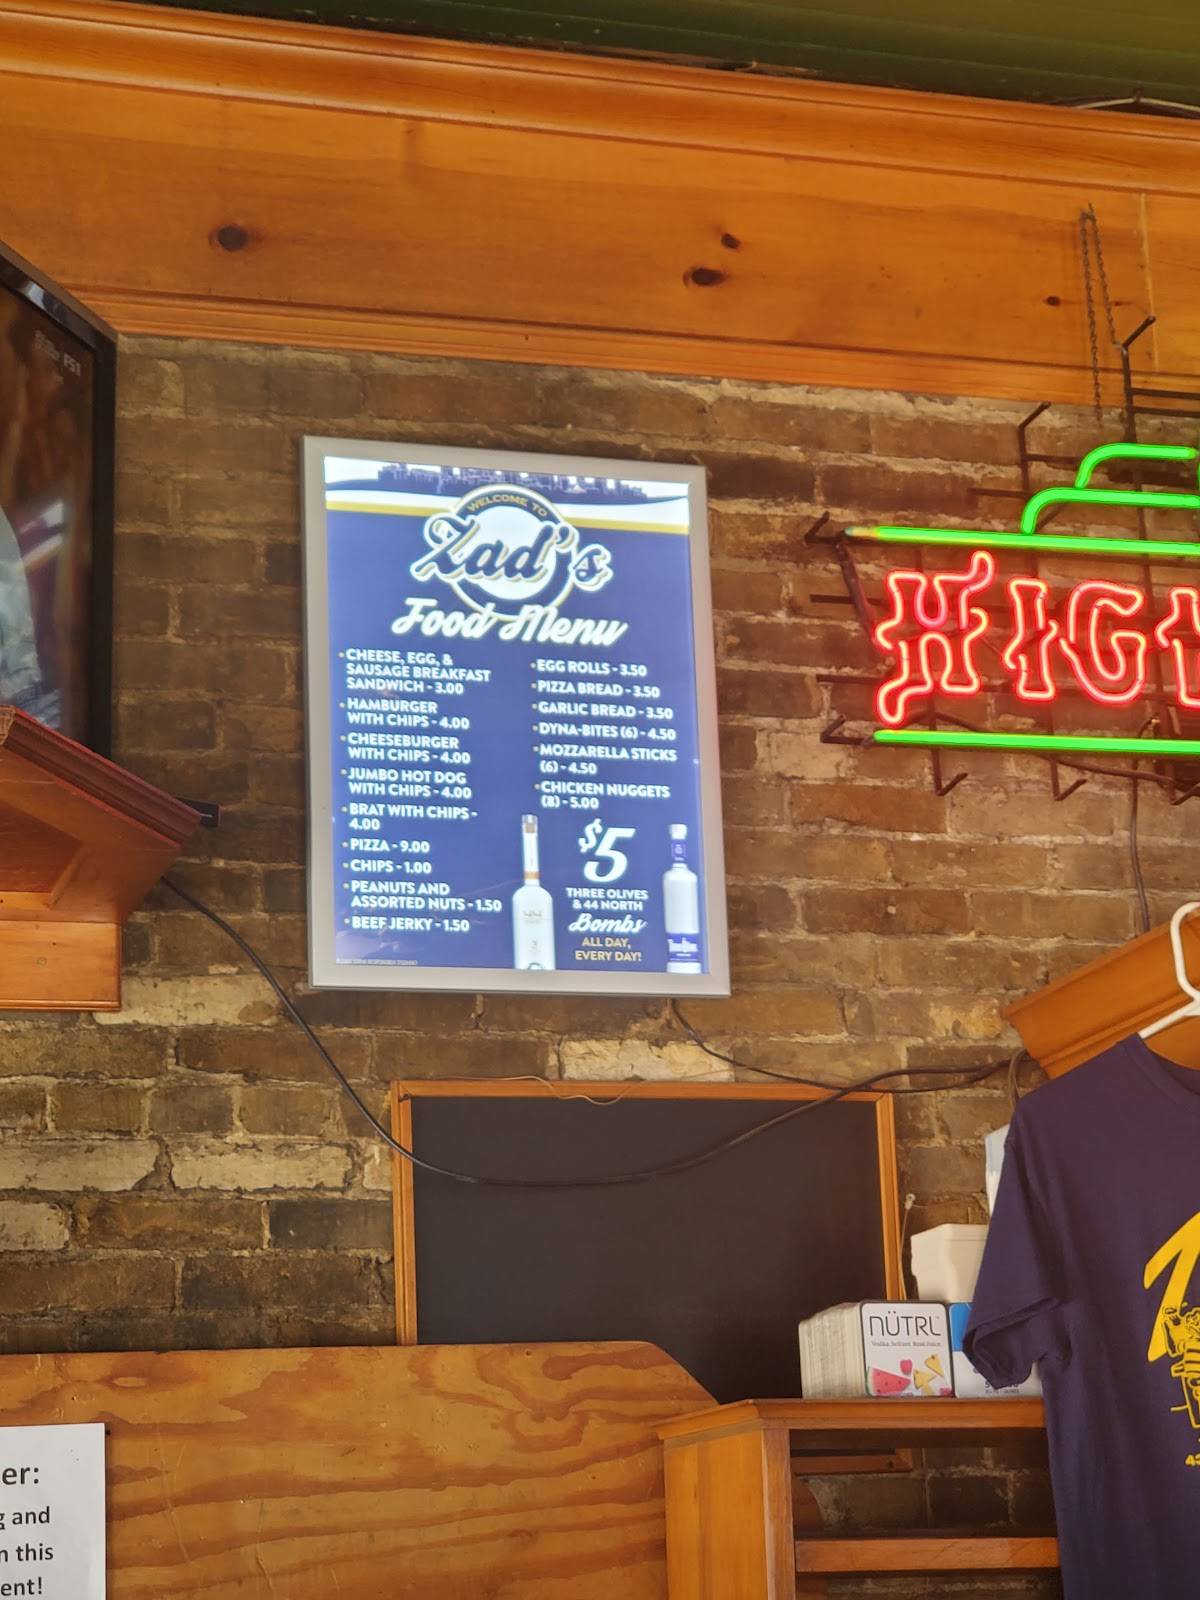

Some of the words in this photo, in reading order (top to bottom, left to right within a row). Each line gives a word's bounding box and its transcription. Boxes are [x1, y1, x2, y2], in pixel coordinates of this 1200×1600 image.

[467, 495, 528, 512] WELCOME
[531, 503, 547, 517] TO
[410, 511, 612, 592] Zad's
[391, 597, 494, 637] Food
[499, 605, 628, 647] Menu
[346, 649, 404, 664] CHEESE,
[408, 653, 440, 666] EGG,
[443, 655, 453, 665] &
[346, 664, 410, 677] SAUSAGE
[413, 668, 491, 681] BREAKFAST
[536, 660, 565, 672] EGG
[568, 661, 610, 674] ROLLS
[620, 664, 647, 677] 3.50
[346, 678, 424, 692] SANDWICH
[435, 682, 464, 694] 3.00
[537, 680, 575, 693] PIZZA
[578, 683, 623, 696] BREAD
[633, 686, 660, 698] 3.50
[347, 698, 437, 713] HAMBURGER
[538, 702, 588, 715] GARLIC
[591, 705, 636, 717] BREAD
[646, 707, 673, 719] 3.50
[348, 713, 383, 725] WITH
[387, 714, 429, 727] CHIPS
[440, 717, 470, 729] 4.00
[539, 723, 618, 737] DYNA-BITES
[621, 727, 638, 739] (6)
[648, 729, 676, 740] 4.50
[348, 733, 459, 749] CHEESEBURGER
[348, 747, 384, 760] WITH
[388, 749, 430, 762] CHIPS
[440, 752, 470, 763] 4.00
[540, 744, 629, 759] MOZZARELLA
[631, 748, 677, 761] STICKS
[540, 761, 558, 773] (6)
[568, 763, 597, 774] 4.50
[348, 768, 398, 781] JUMBO
[402, 771, 432, 782] HOT
[434, 772, 467, 784] DOG
[349, 783, 385, 795] WITH
[389, 784, 431, 797] CHIPS
[441, 787, 472, 798] 4.00
[541, 781, 604, 795] CHICKEN
[607, 784, 670, 797] NUGGETS
[571, 797, 599, 808] 5.00
[349, 804, 385, 816] BRAT
[387, 806, 424, 817] WITH
[426, 807, 469, 819] CHIPS
[349, 819, 380, 830] 4.00
[350, 839, 390, 851] PIZZA
[400, 841, 429, 853] 9.00
[578, 817, 637, 883] $5
[350, 860, 394, 872] CHIPS
[404, 862, 432, 874] 1.00
[351, 881, 415, 894] PEANUTS
[418, 883, 450, 895] AND
[566, 888, 605, 898] THREE
[607, 889, 649, 900] OLIVES
[351, 896, 425, 910] ASSORTED
[429, 898, 465, 911] NUTS
[475, 899, 502, 912] 1.50
[573, 900, 581, 909] &
[583, 900, 598, 910] 44
[600, 900, 643, 911] NORTH
[352, 917, 387, 928] BEEF
[389, 918, 432, 930] JERKY
[443, 919, 470, 932] 1.50
[569, 913, 647, 933] Bombs
[582, 937, 603, 946] ALL
[605, 938, 631, 948] DAY,
[575, 951, 613, 961] EVERY
[615, 951, 642, 961] DAY!
[870, 1311, 941, 1336] NÜTRL
[12, 1506, 50, 1525] and
[16, 1543, 53, 1562] this
[1, 1577, 42, 1596] ent!
